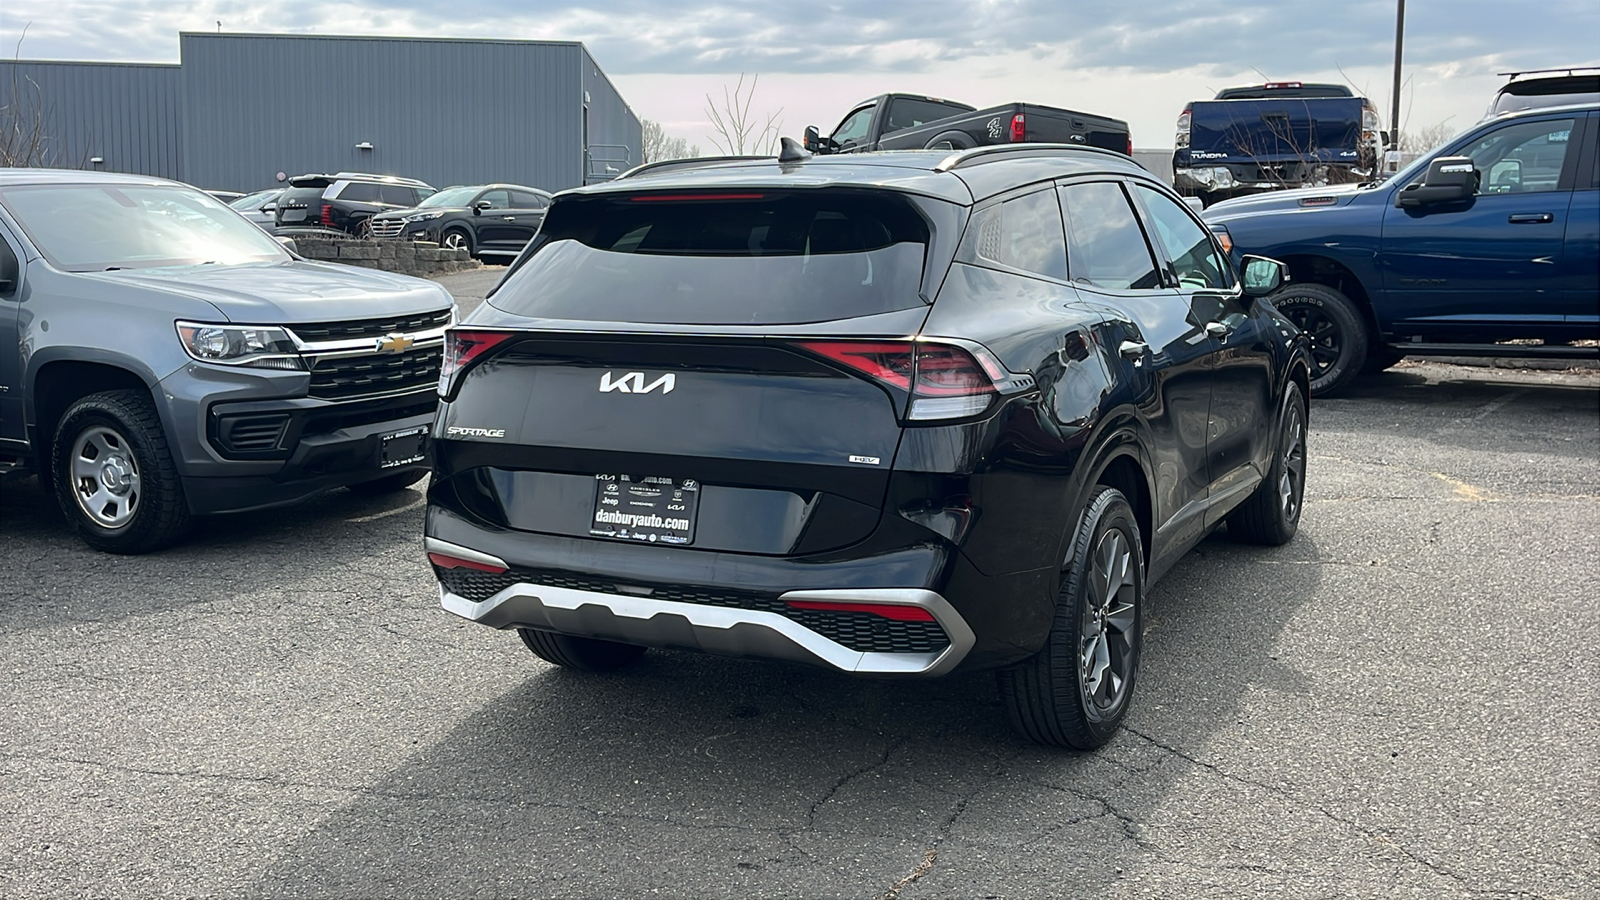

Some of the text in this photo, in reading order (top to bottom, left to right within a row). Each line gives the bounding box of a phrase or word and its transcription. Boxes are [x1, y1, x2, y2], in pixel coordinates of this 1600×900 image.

[599, 371, 676, 395] KIA
[447, 426, 506, 438] SPORTAGE
[602, 496, 619, 507] Jeep
[595, 509, 689, 531] danburyauto.com
